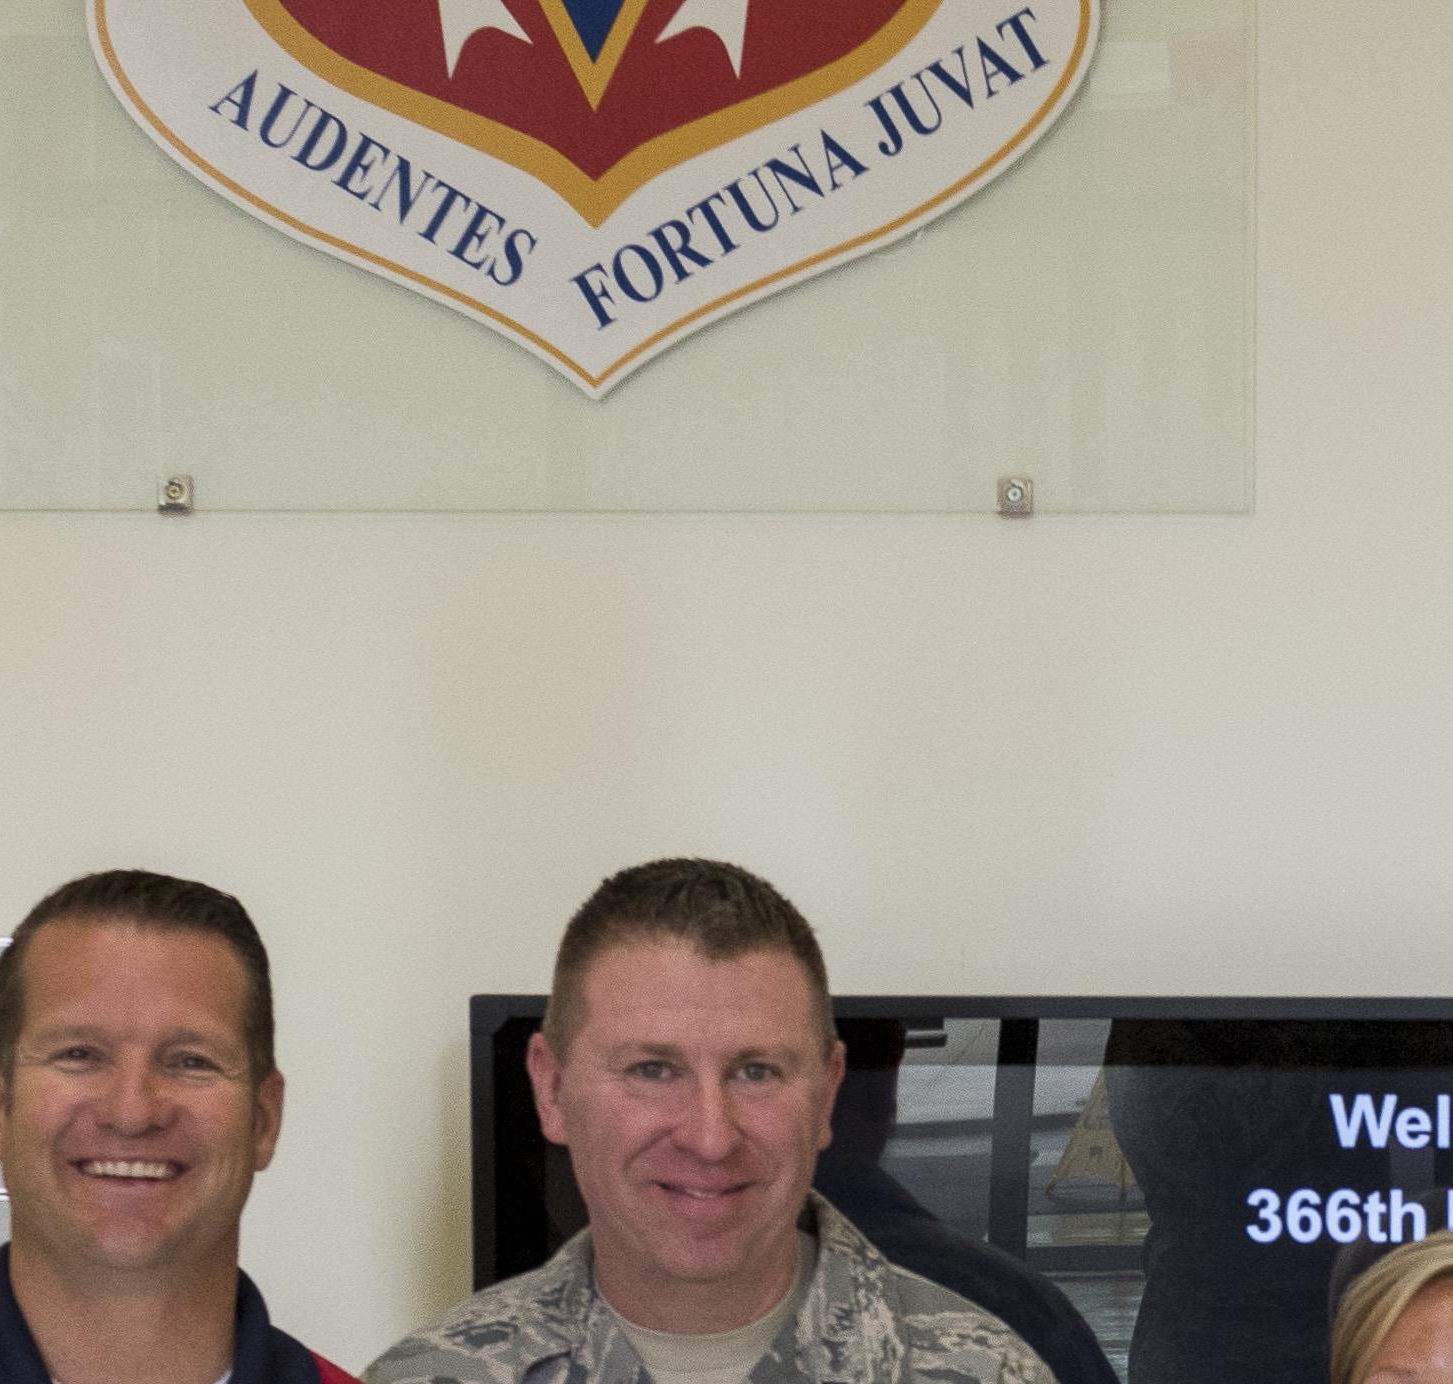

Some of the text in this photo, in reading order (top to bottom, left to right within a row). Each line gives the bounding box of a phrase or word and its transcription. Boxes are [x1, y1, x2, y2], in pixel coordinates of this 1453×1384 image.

[208, 7, 1052, 332] AUDENTES FORTUNA JUVAT
[1247, 1189, 1427, 1243] 366th
